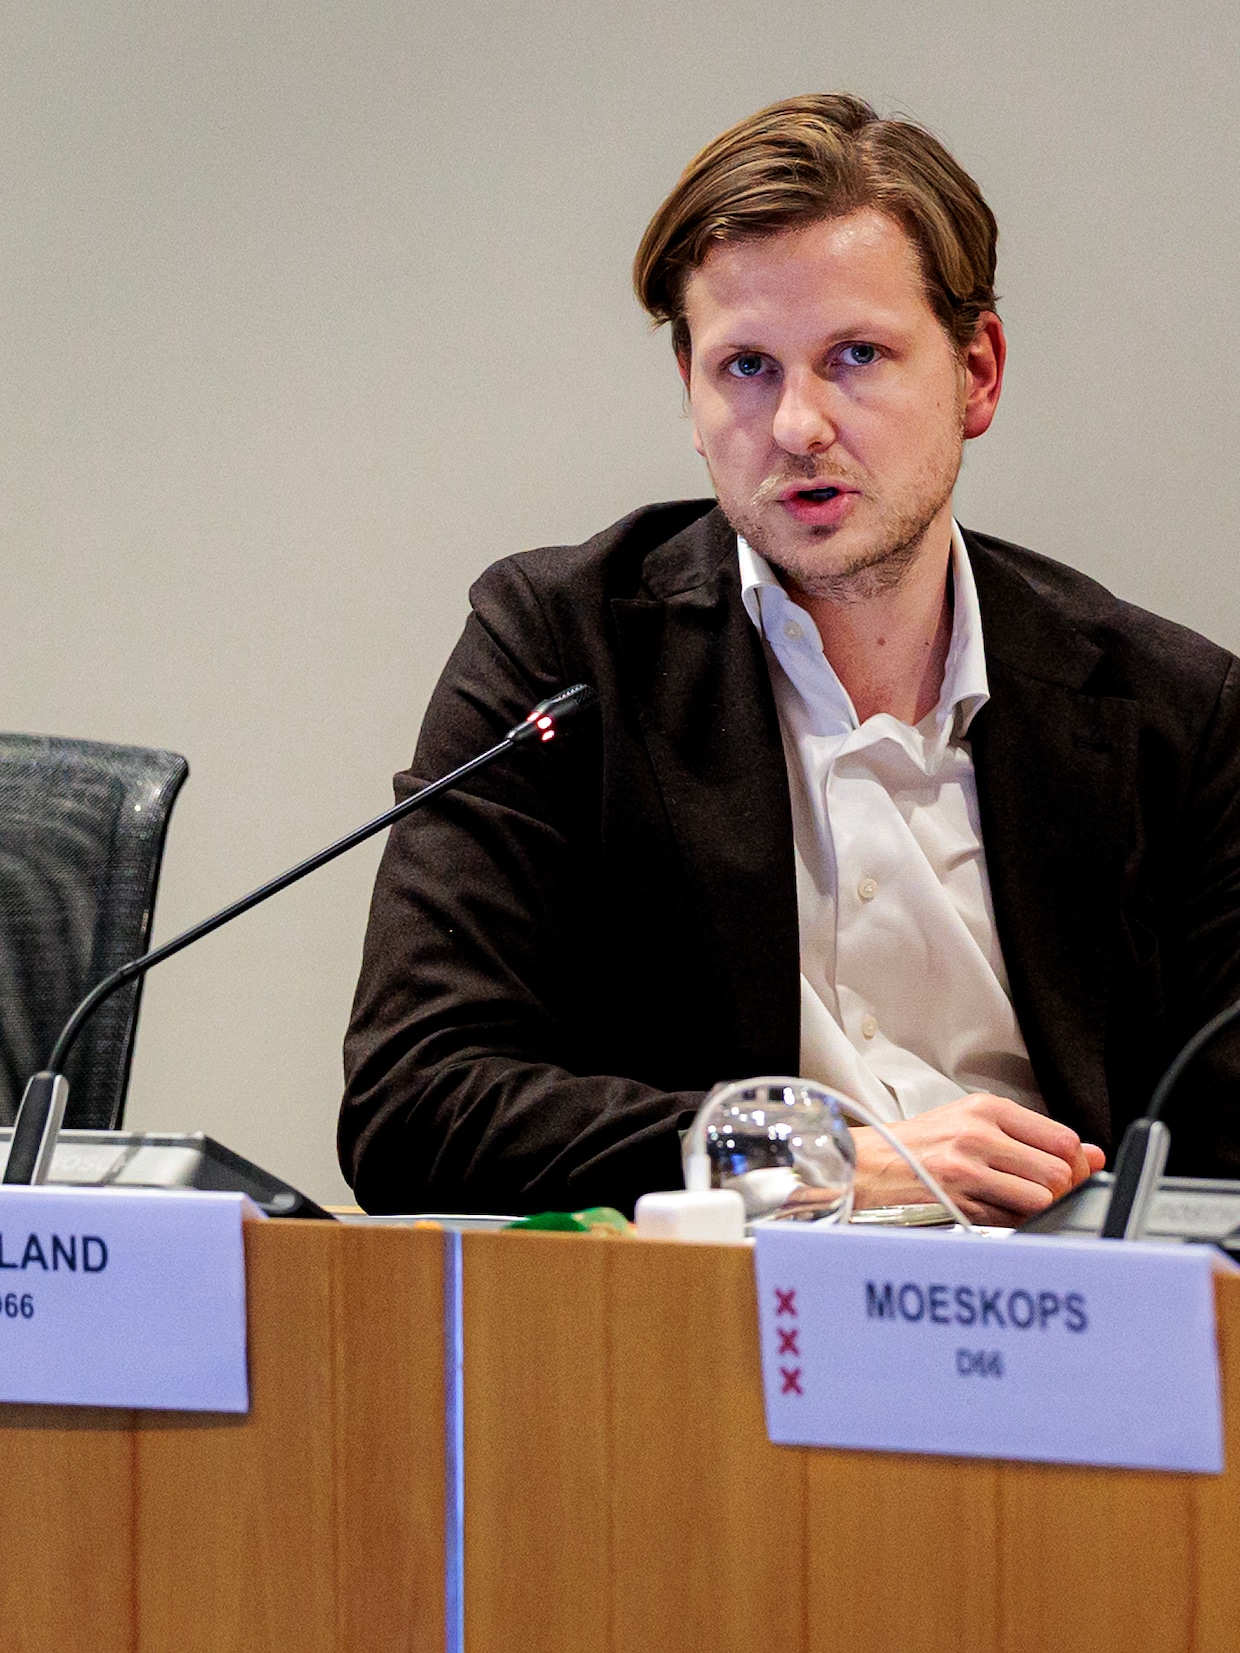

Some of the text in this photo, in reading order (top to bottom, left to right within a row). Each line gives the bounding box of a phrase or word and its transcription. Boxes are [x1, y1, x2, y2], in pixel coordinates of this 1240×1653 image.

[0, 1232, 109, 1273] LAND
[0, 1292, 35, 1319] 66
[864, 1279, 1089, 1334] MOESKOPS
[955, 1347, 1005, 1380] D66
